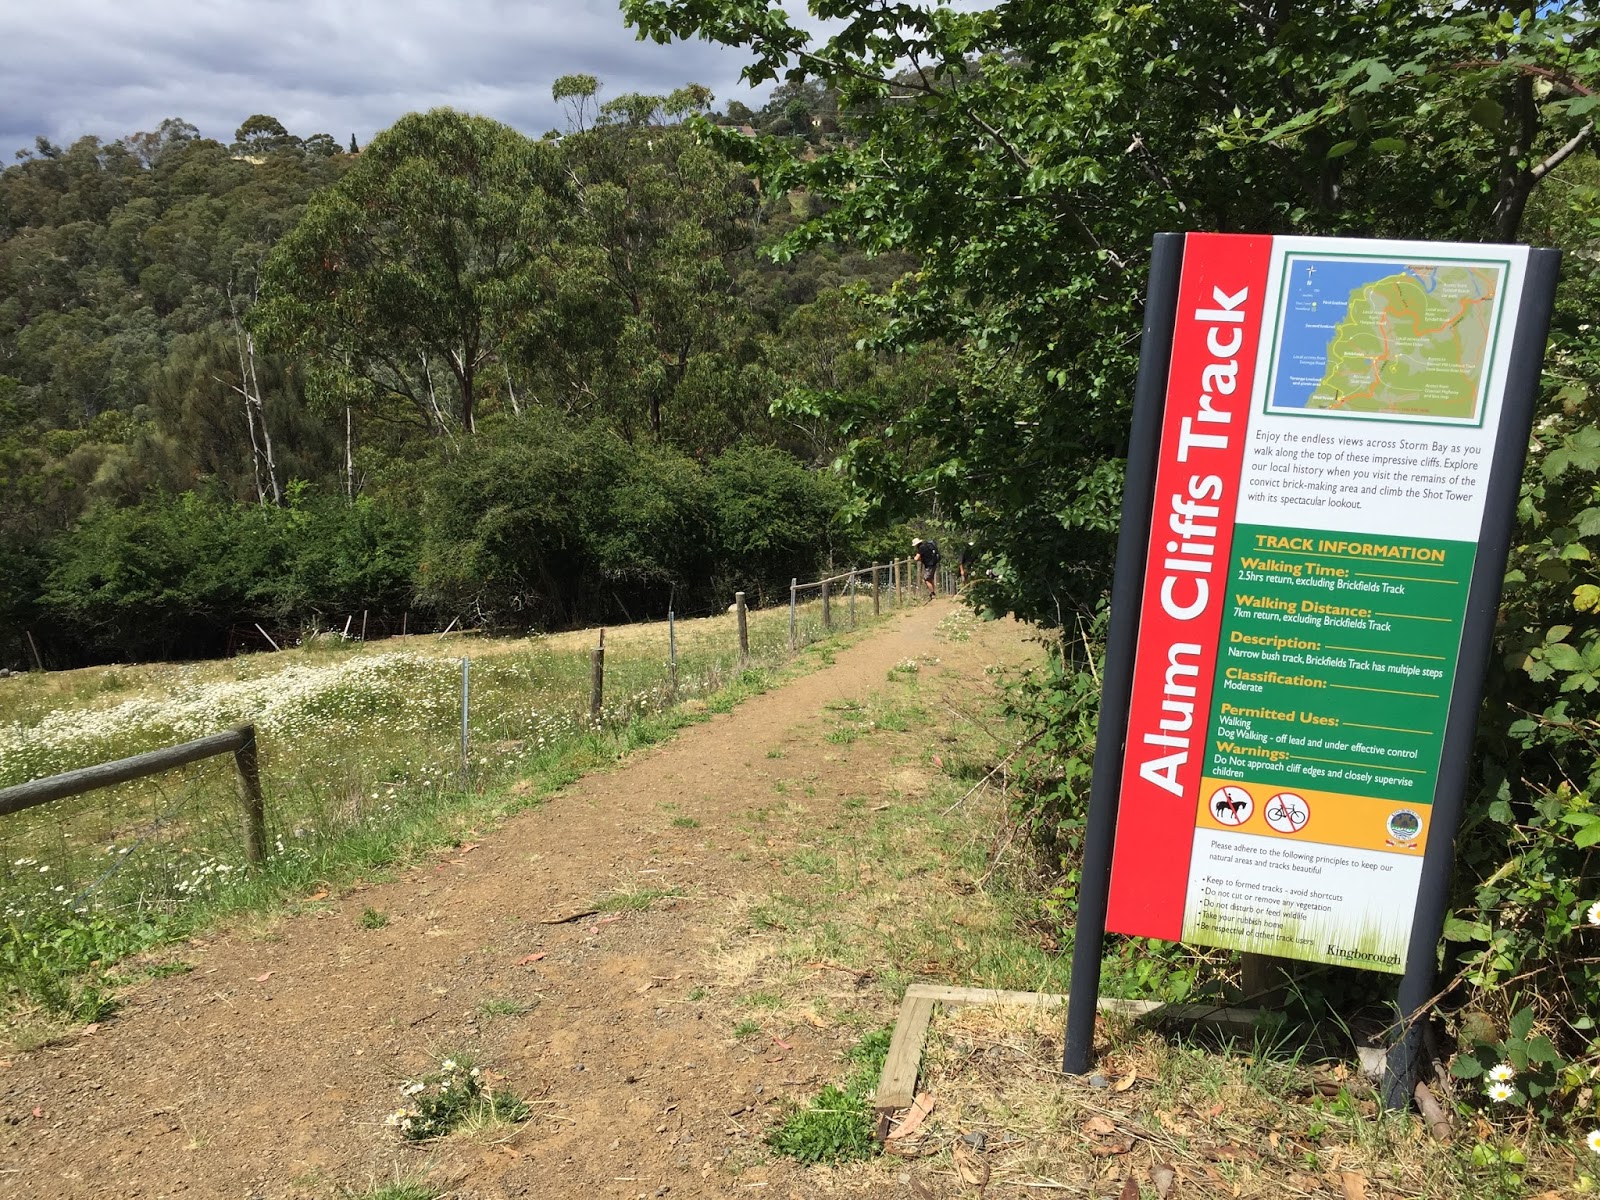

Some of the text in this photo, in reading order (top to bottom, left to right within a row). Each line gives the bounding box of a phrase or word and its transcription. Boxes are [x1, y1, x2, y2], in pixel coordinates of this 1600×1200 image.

[1255, 429, 1481, 456] Enjoy the endless views across Storm Bay as you
[1253, 446, 1478, 471] walk along the top of these impressive cliffs. Explore
[1251, 461, 1476, 486] our local history when you visit the remains of the
[1247, 491, 1265, 501] with
[1267, 493, 1278, 503] its
[1280, 496, 1326, 506] spectacular
[1249, 478, 1473, 501] convict brick-making area and climb the Shot Tower
[1140, 286, 1249, 797] Alum Cliffs Track
[1256, 534, 1445, 562] TRACK INFORMATION
[1240, 557, 1350, 577] Walking Time:
[1238, 570, 1404, 594] 2.5hrs return, excluding Brickfields Track
[1236, 594, 1372, 618] Walking Distance:
[1233, 607, 1391, 631] 7km return, excluding Brickfields Track
[1230, 630, 1321, 650] Description:
[1228, 646, 1443, 679] Narrow bush track, Brickfields Track has multiple steps
[1223, 679, 1262, 692] Moderate
[1225, 667, 1327, 688] Classification:
[1219, 715, 1251, 730] Walking
[1221, 703, 1339, 726] Permitted Uses:
[1216, 741, 1290, 761] Warnings:
[1217, 726, 1235, 740] Dog
[1236, 729, 1268, 743] Walking
[1275, 733, 1288, 743] off
[1288, 735, 1305, 745] lead
[1307, 738, 1323, 747] and
[1324, 741, 1349, 750] under
[1350, 742, 1385, 755] effective
[1387, 749, 1417, 758] control
[1212, 766, 1244, 777] children
[1214, 753, 1413, 786] Do Not approach cliff edges and closely supervise
[1209, 853, 1322, 874] natural areas and tracks beautiful
[1210, 839, 1232, 850] Please
[1233, 843, 1257, 854] adhere
[1268, 848, 1281, 857] the
[1282, 849, 1314, 863] following
[1315, 856, 1349, 866] principles
[1350, 860, 1360, 868] to
[1360, 860, 1378, 871] keep
[1205, 887, 1216, 895] Do
[1217, 890, 1230, 898] not
[1231, 892, 1242, 900] cut
[1254, 896, 1281, 905] remove
[1281, 899, 1295, 909] any
[1295, 902, 1332, 912] vegetation
[1206, 875, 1224, 886] Keep
[1235, 879, 1260, 890] formed
[1261, 884, 1283, 893] tracks
[1289, 888, 1309, 897] avoid
[1309, 890, 1343, 902] shortcuts
[1202, 910, 1283, 929] Take your rubbish home
[1203, 899, 1214, 907] Do
[1216, 901, 1228, 909] not
[1230, 902, 1254, 913] disturb
[1265, 907, 1281, 917] feed
[1283, 911, 1307, 921] wildlife
[1201, 922, 1314, 946] Be respectful of other track users
[1326, 944, 1401, 966] Kingborough
